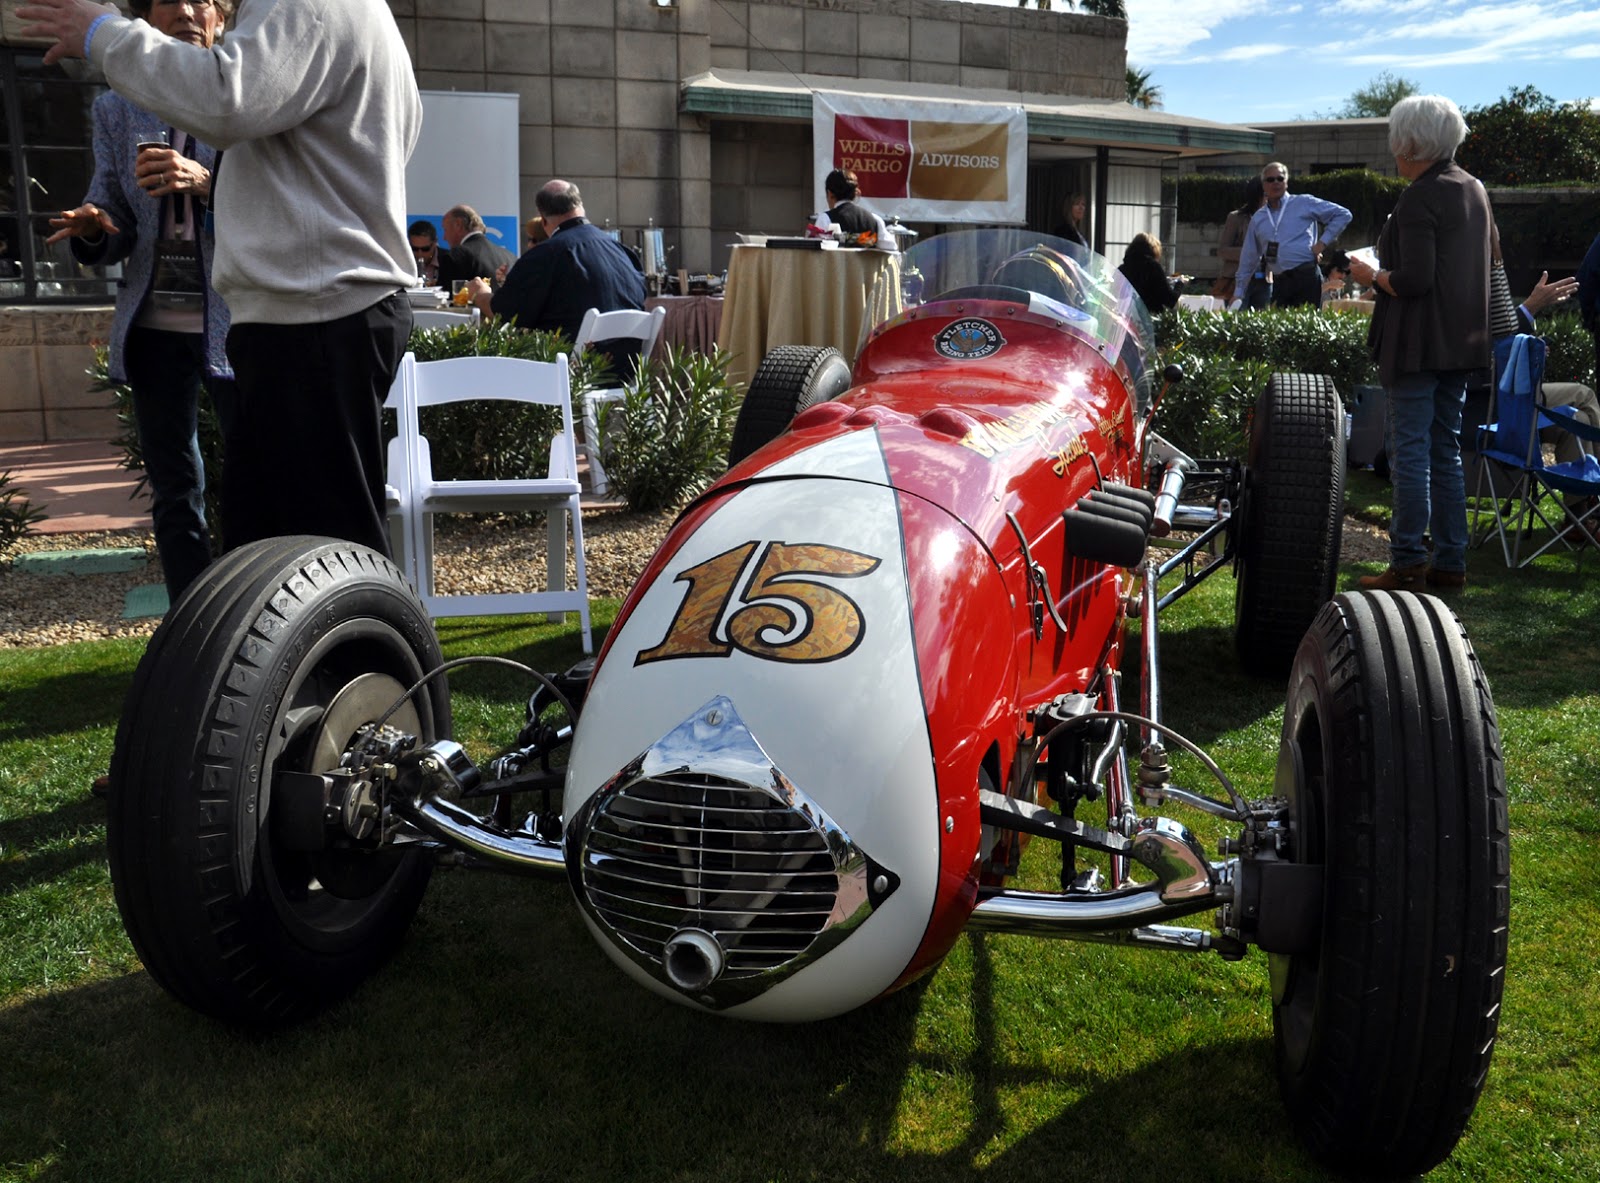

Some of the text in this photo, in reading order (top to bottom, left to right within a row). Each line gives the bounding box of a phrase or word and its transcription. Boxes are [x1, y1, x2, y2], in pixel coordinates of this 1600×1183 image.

[839, 139, 905, 156] WELLS
[841, 156, 903, 173] FARGO
[918, 152, 1000, 169] ADVISORS
[942, 321, 997, 342] FLETCHER
[940, 341, 995, 358] RACING TEAM
[633, 540, 883, 668] 15
